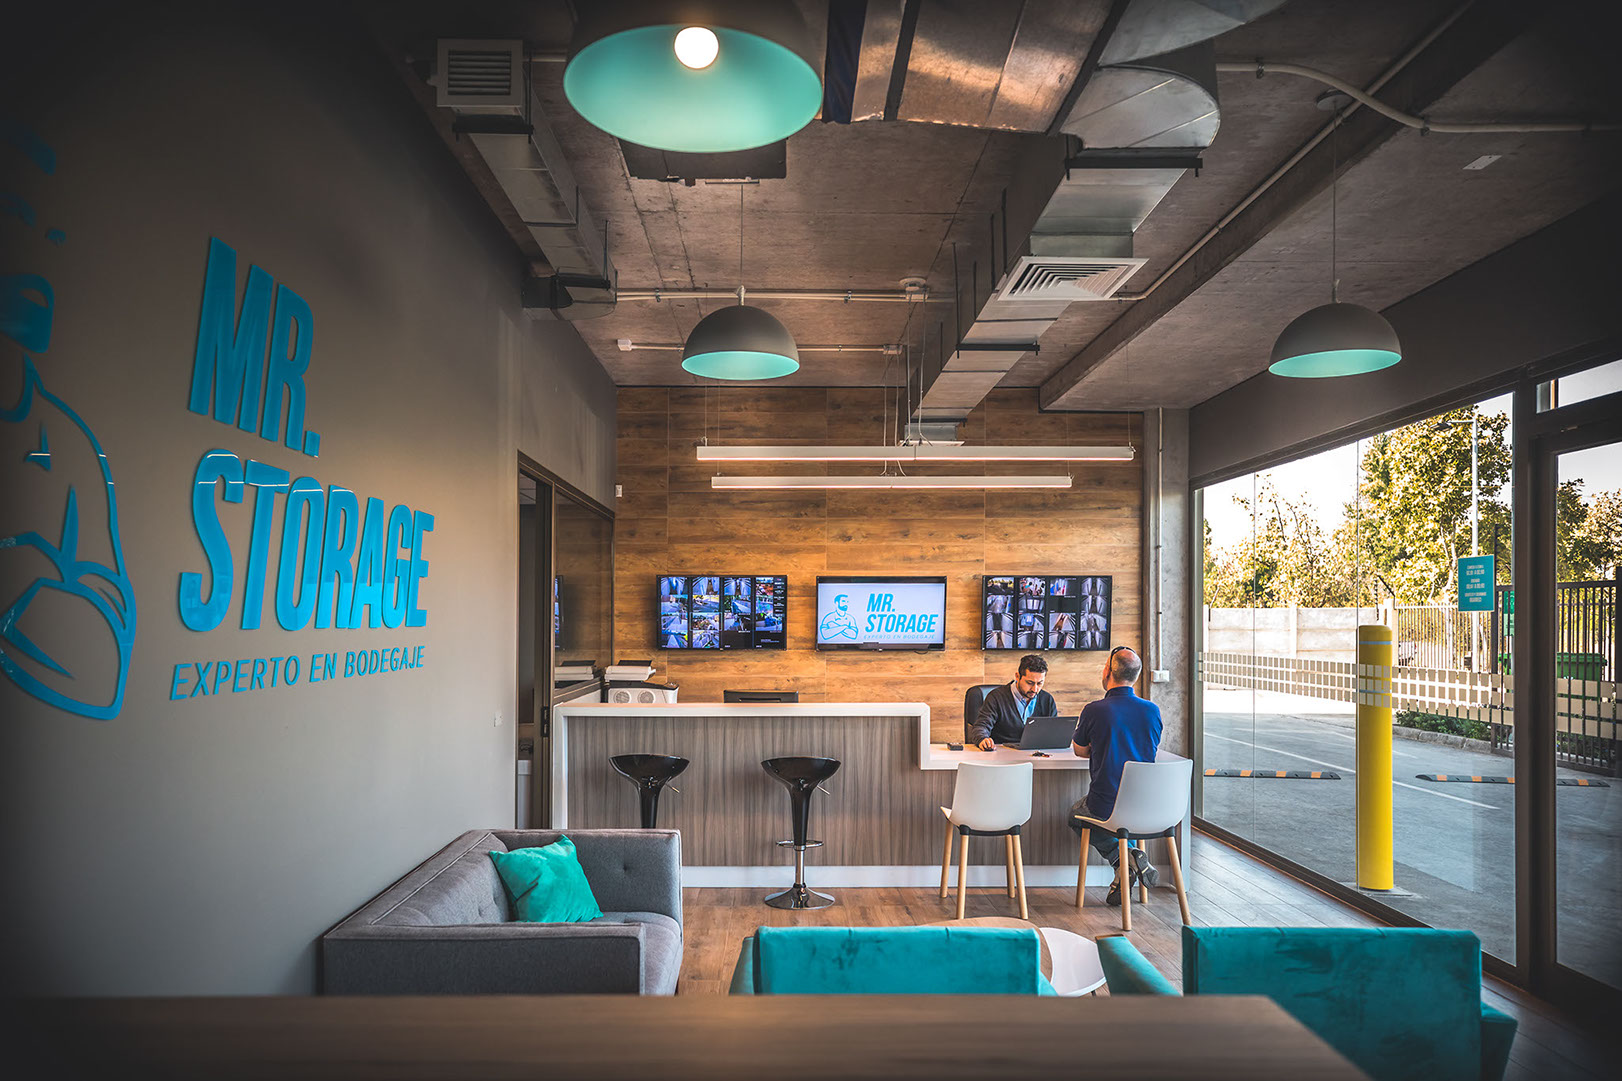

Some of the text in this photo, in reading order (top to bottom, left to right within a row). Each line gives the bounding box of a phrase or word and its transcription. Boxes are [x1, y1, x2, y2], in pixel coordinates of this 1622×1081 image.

[188, 236, 320, 457] MR.
[180, 449, 434, 632] STORAGE
[865, 614, 938, 632] STORAGE
[866, 593, 895, 612] MR.
[170, 645, 426, 700] EXPERTO EN BODEGAJE
